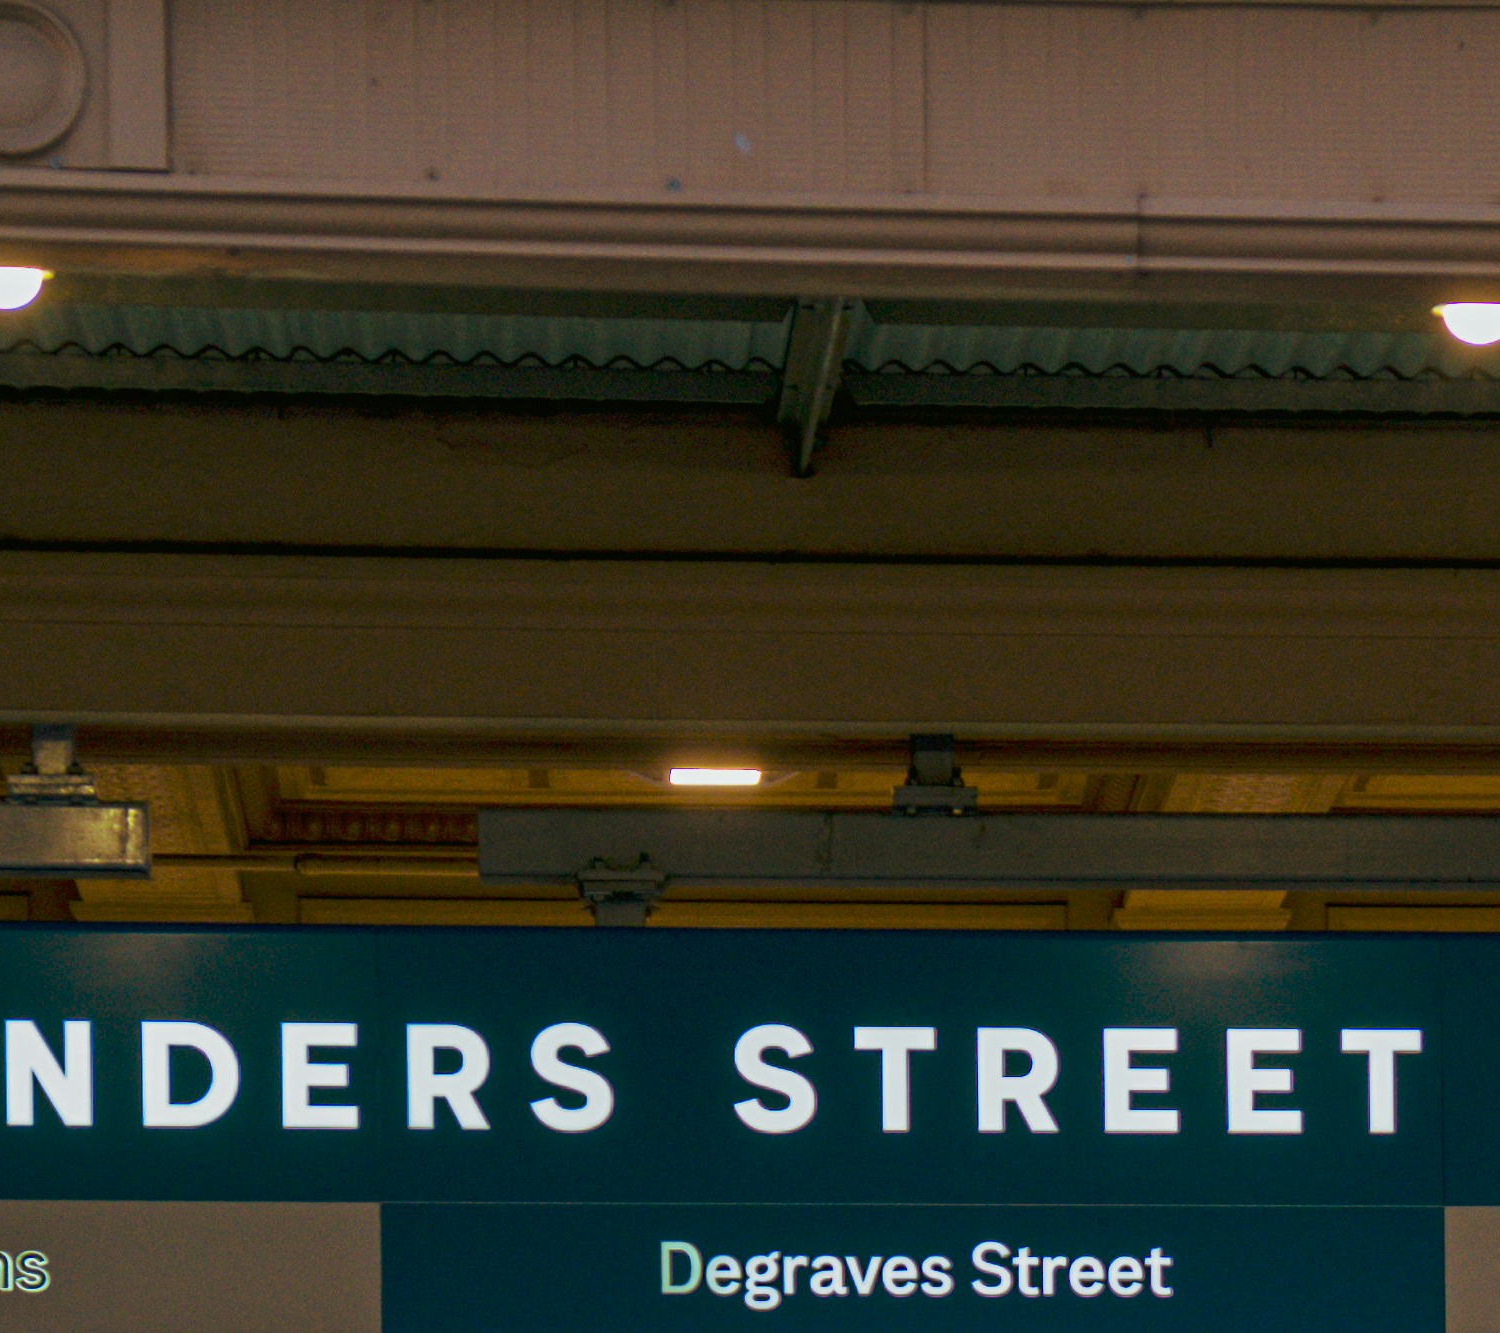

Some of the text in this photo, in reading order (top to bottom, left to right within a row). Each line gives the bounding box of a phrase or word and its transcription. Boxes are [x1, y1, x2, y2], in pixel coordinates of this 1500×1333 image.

[732, 1024, 1424, 1134] STREET
[660, 1241, 1173, 1311] Degraves Street
